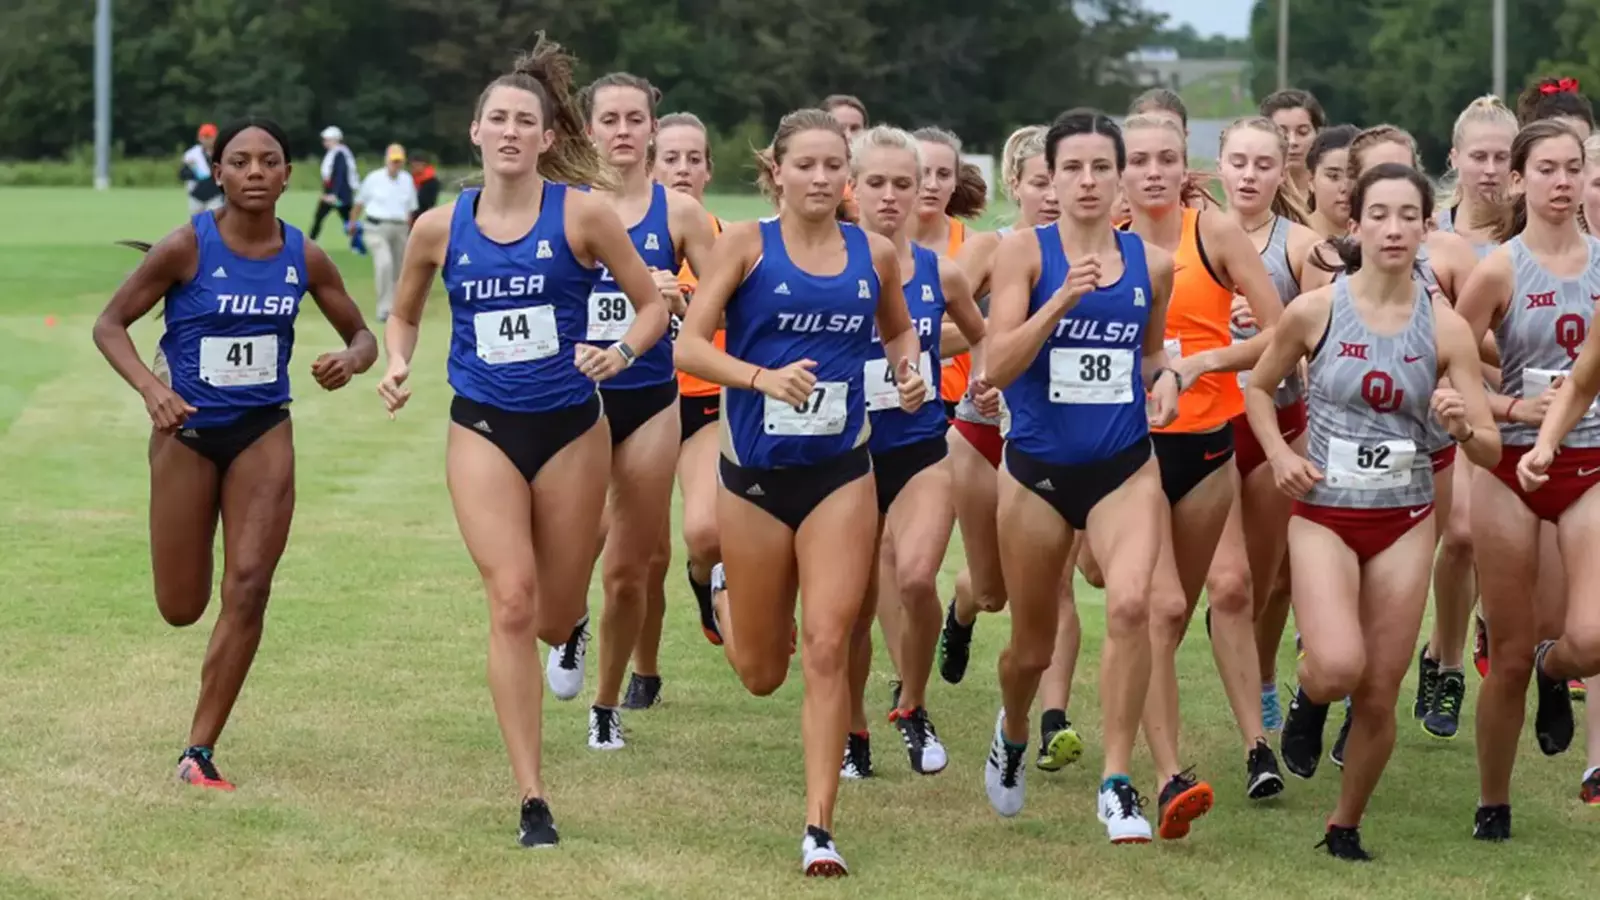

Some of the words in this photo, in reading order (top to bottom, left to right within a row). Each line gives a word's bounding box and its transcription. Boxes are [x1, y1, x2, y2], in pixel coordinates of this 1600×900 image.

[461, 274, 545, 301] TULSA
[217, 294, 295, 315] TULSA
[598, 297, 627, 321] 39
[1526, 290, 1557, 310] XII
[499, 313, 530, 341] 44
[777, 313, 864, 333] TULSA
[1054, 318, 1140, 343] TULSA
[226, 342, 254, 366] 41
[1337, 341, 1369, 361] XII
[1079, 353, 1112, 381] 38
[1361, 370, 1405, 414] OU
[1356, 445, 1391, 470] 52
